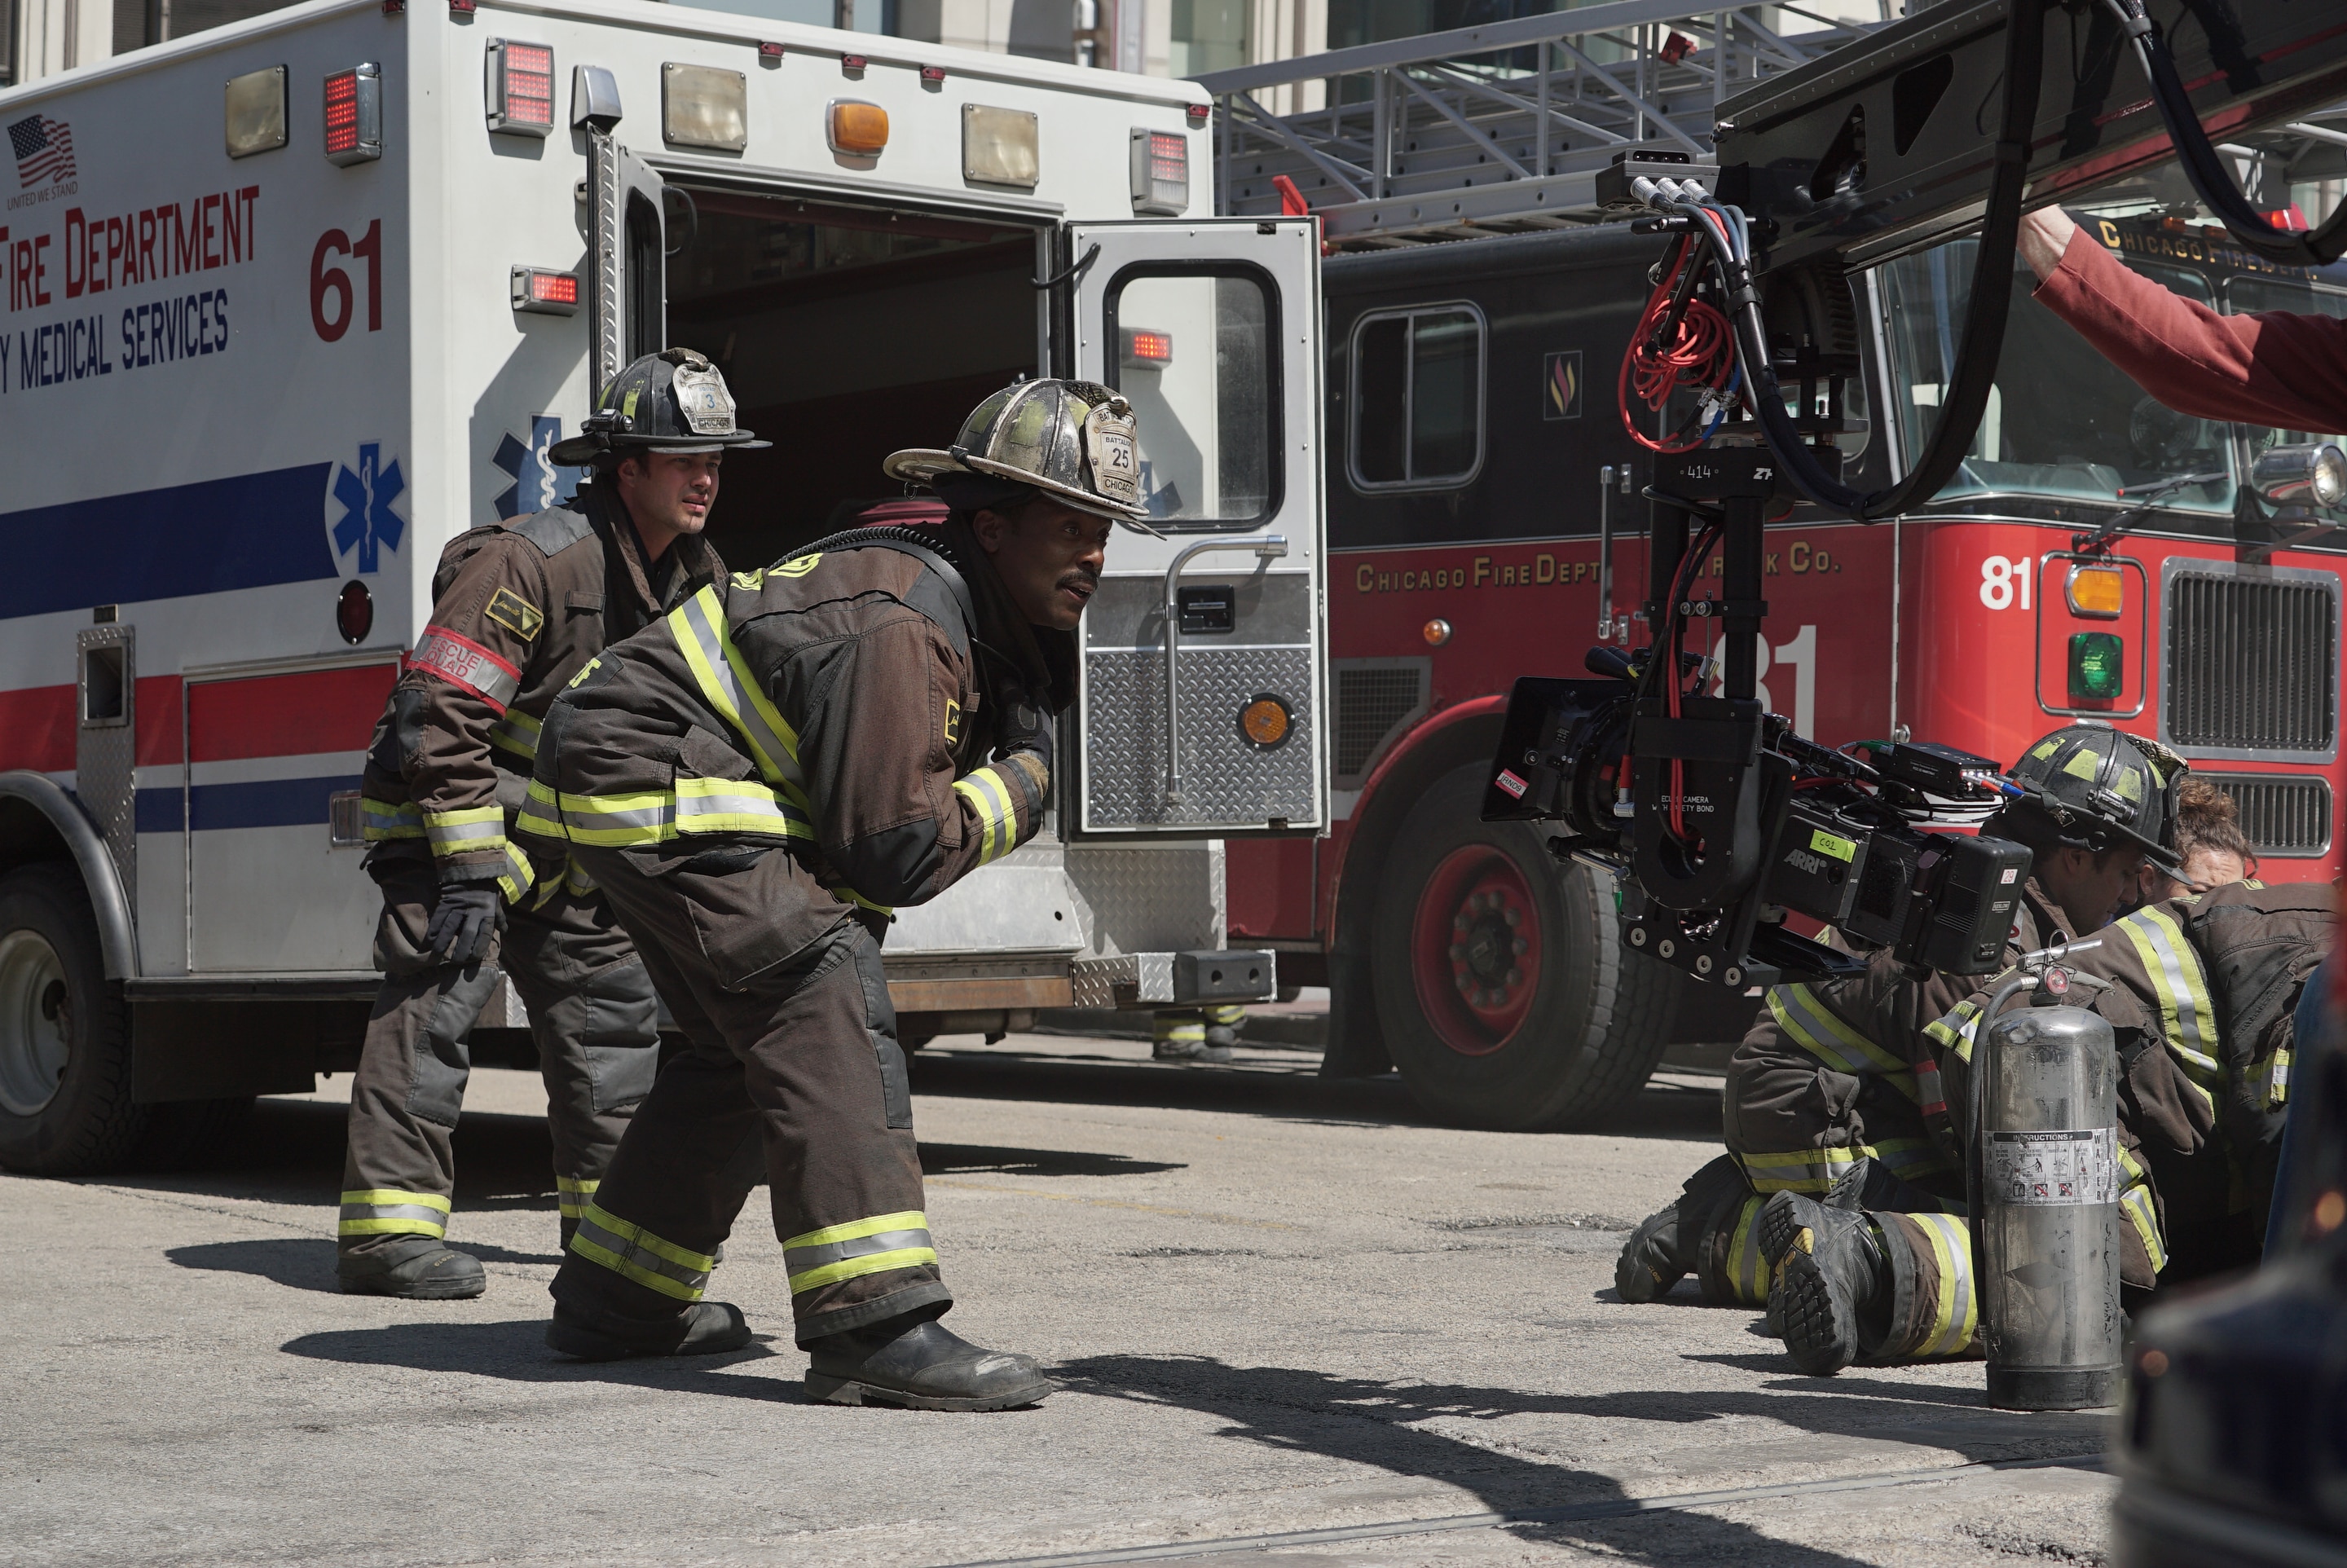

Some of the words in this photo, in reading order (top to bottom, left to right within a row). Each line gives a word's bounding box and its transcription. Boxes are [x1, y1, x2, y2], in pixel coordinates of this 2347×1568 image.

[7, 192, 36, 210] UNITED
[37, 187, 50, 203] WE
[51, 181, 78, 200] STAND
[65, 184, 260, 300] DEPARTMENT
[2098, 220, 2202, 261] CHICAGO
[310, 218, 382, 343] 61
[20, 314, 112, 390] MEDICAL
[122, 288, 228, 370] SERVICES
[705, 394, 716, 409] 3
[698, 418, 730, 428] CHICAGO
[1105, 436, 1131, 447] BATTALION
[1112, 447, 1129, 469] 25
[1687, 465, 1711, 479] 414
[1104, 478, 1133, 495] CHICAGO
[1356, 563, 1465, 592] CHICAGO
[1979, 555, 2032, 610] 81
[421, 651, 469, 678] QUAD
[429, 638, 481, 670] ESCUE
[1683, 795, 1709, 804] CAMERA
[1784, 848, 1821, 875] ARRI
[2004, 870, 2015, 883] 29
[2013, 1134, 2068, 1142] INRUCTIONS
